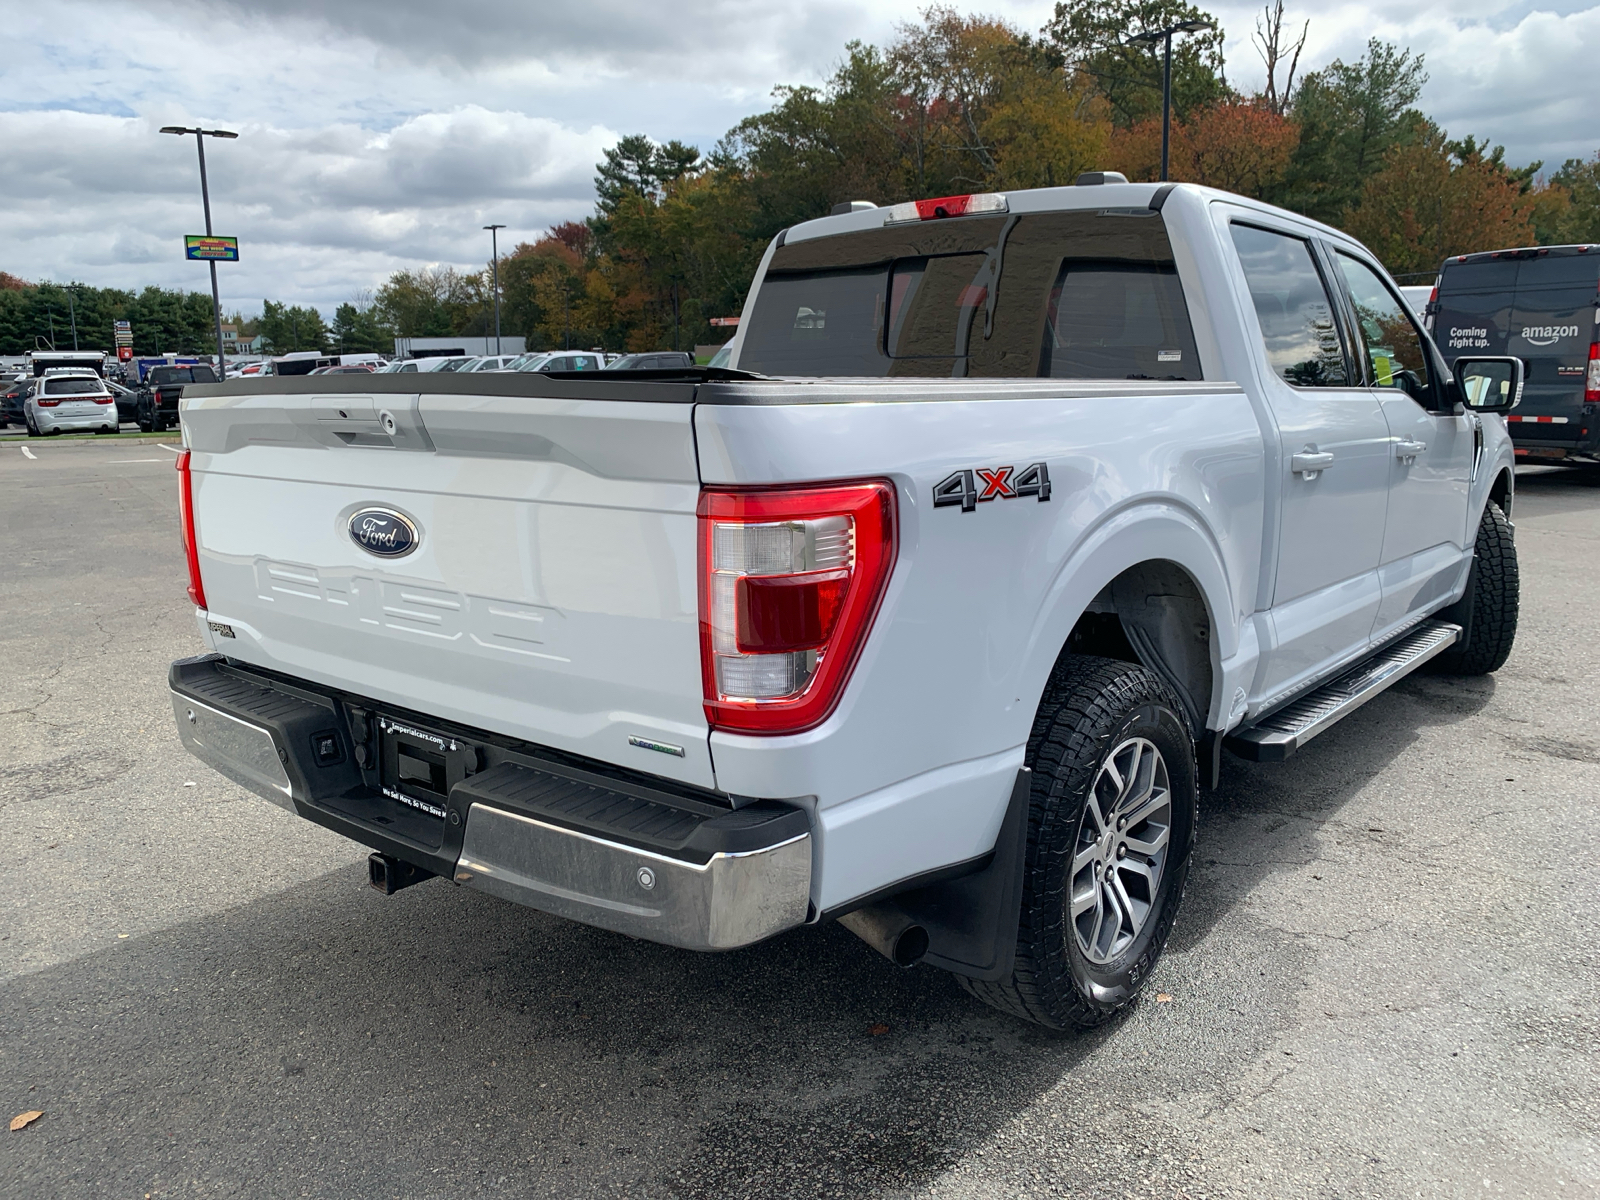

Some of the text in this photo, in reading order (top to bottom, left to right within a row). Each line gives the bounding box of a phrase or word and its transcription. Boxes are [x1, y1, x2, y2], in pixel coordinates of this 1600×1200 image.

[1450, 326, 1487, 338] Coming
[1521, 325, 1579, 339] amazon
[1448, 337, 1491, 349] right up.
[359, 516, 398, 548] Ford
[382, 787, 391, 798] We
[391, 790, 400, 800] Sell
[412, 800, 420, 808] So
[419, 802, 430, 812] You
[429, 806, 442, 817] Save
